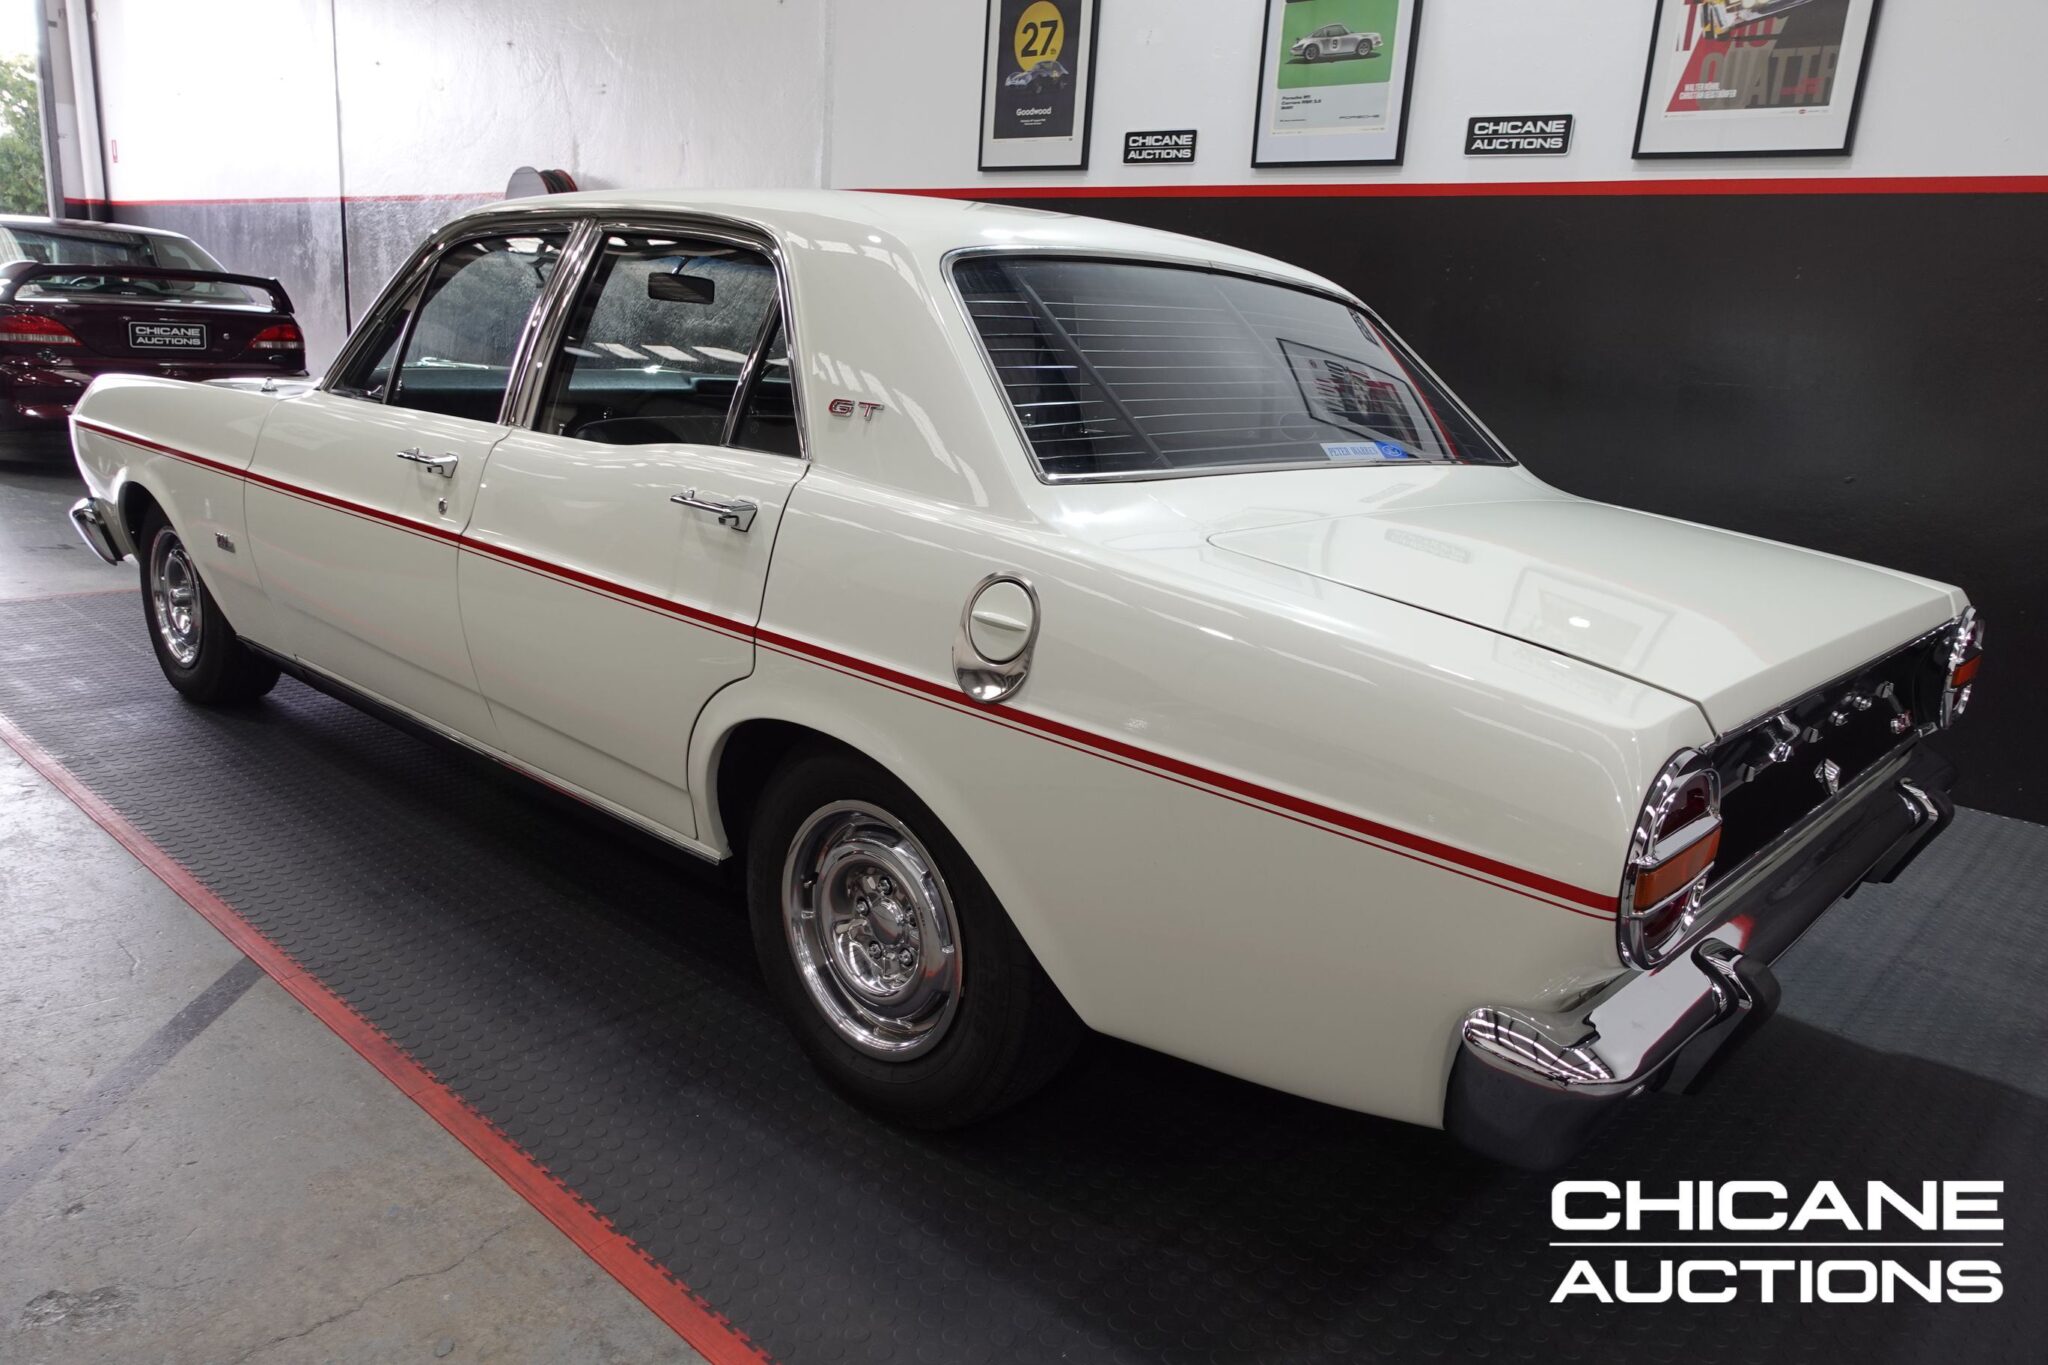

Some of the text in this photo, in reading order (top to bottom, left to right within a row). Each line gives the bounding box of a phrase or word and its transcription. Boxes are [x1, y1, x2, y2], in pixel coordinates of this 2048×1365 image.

[1021, 20, 1058, 57] 27
[1016, 106, 1052, 116] Goodwood
[1473, 120, 1567, 135] CHICANE
[1128, 134, 1194, 147] CHICANE
[1471, 138, 1564, 150] AUCTIONS
[1127, 149, 1192, 159] AUCTIONS
[135, 326, 201, 336] CHICANE
[136, 336, 201, 346] AUCTIONS
[828, 398, 884, 422] GT
